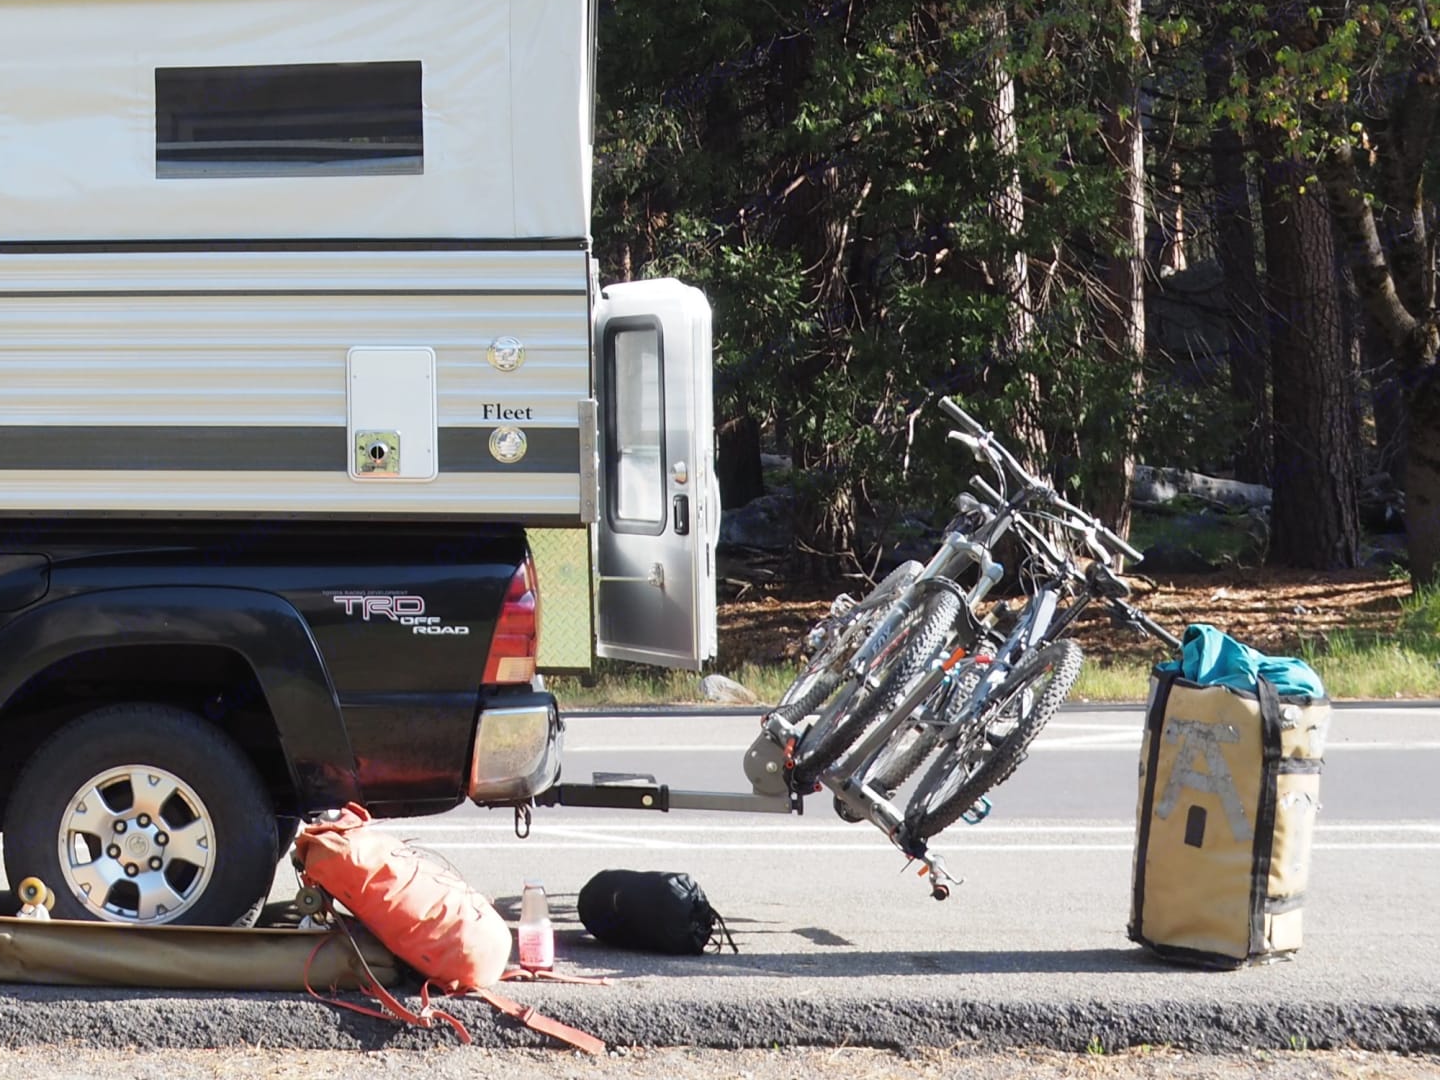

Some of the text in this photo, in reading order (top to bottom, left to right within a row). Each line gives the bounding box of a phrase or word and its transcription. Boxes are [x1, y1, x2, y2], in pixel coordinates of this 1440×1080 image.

[481, 403, 533, 420] Fleet
[333, 596, 425, 620] TRD
[400, 617, 441, 625] OFF
[413, 626, 470, 634] ROAD
